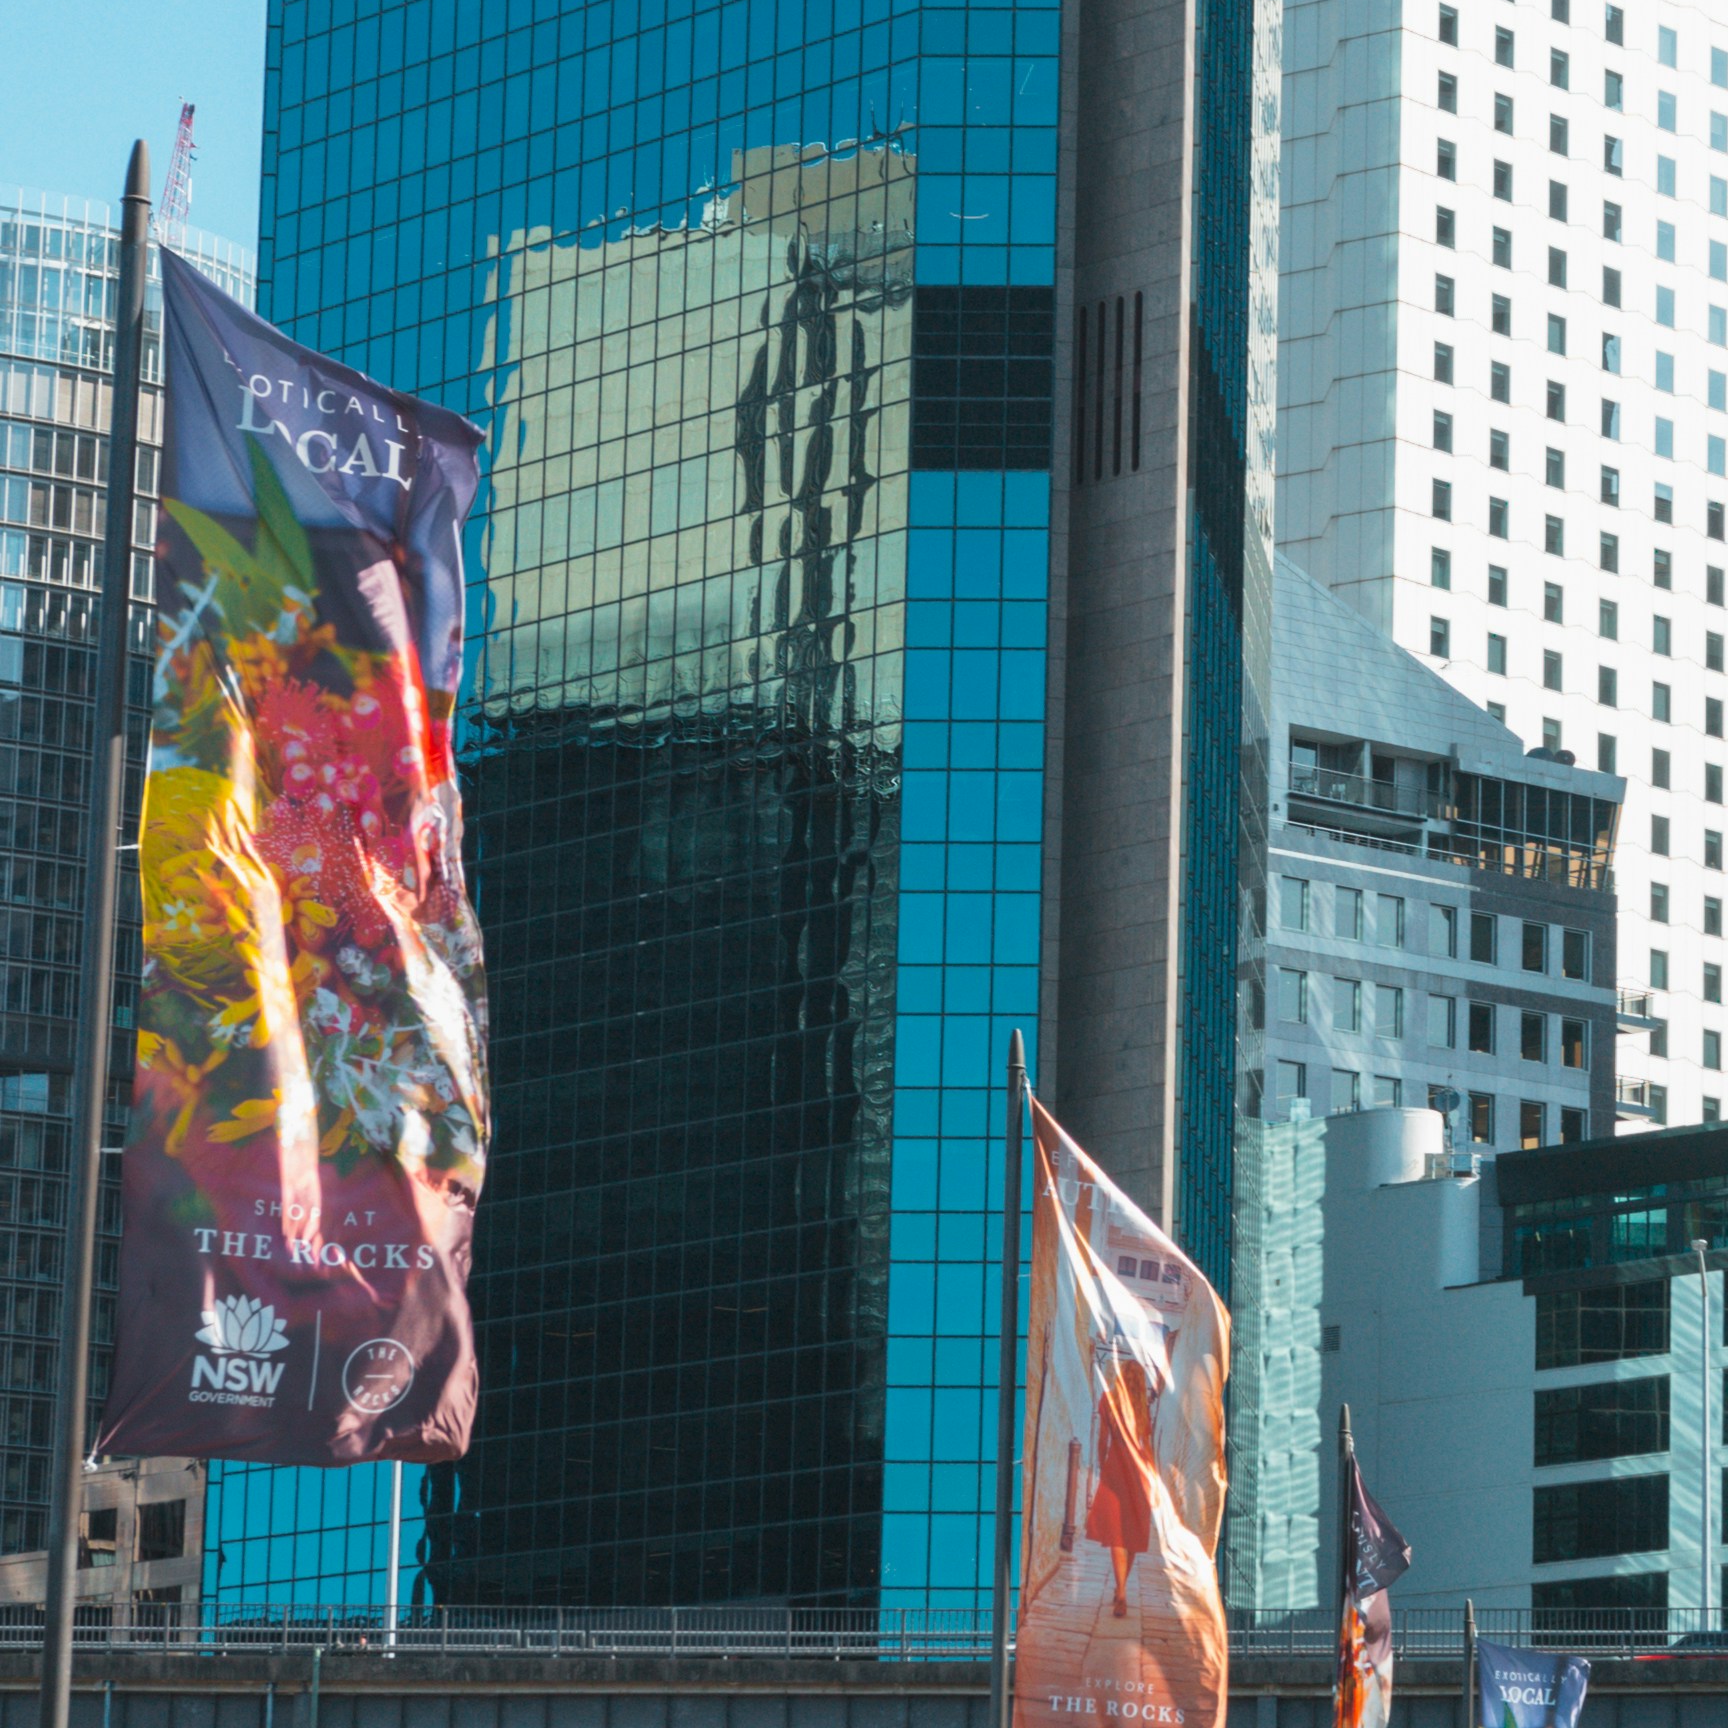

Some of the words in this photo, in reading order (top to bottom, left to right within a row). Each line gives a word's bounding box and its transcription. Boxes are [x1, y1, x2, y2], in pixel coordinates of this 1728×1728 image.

[254, 1199, 322, 1222] SHOP
[344, 1210, 377, 1226] AT
[193, 1227, 273, 1260] THE
[290, 1239, 435, 1270] ROCKS
[367, 1346, 398, 1362] THE
[191, 1355, 286, 1394] NSW
[188, 1390, 276, 1408] GOVERNMENT
[352, 1384, 401, 1407] ROCKS
[1085, 1677, 1155, 1695] EXPLORE
[1494, 1670, 1568, 1685] EXOTICALLY
[1499, 1685, 1556, 1706] LOCAL
[1048, 1695, 1097, 1714] THE
[1106, 1700, 1185, 1724] ROCKS
